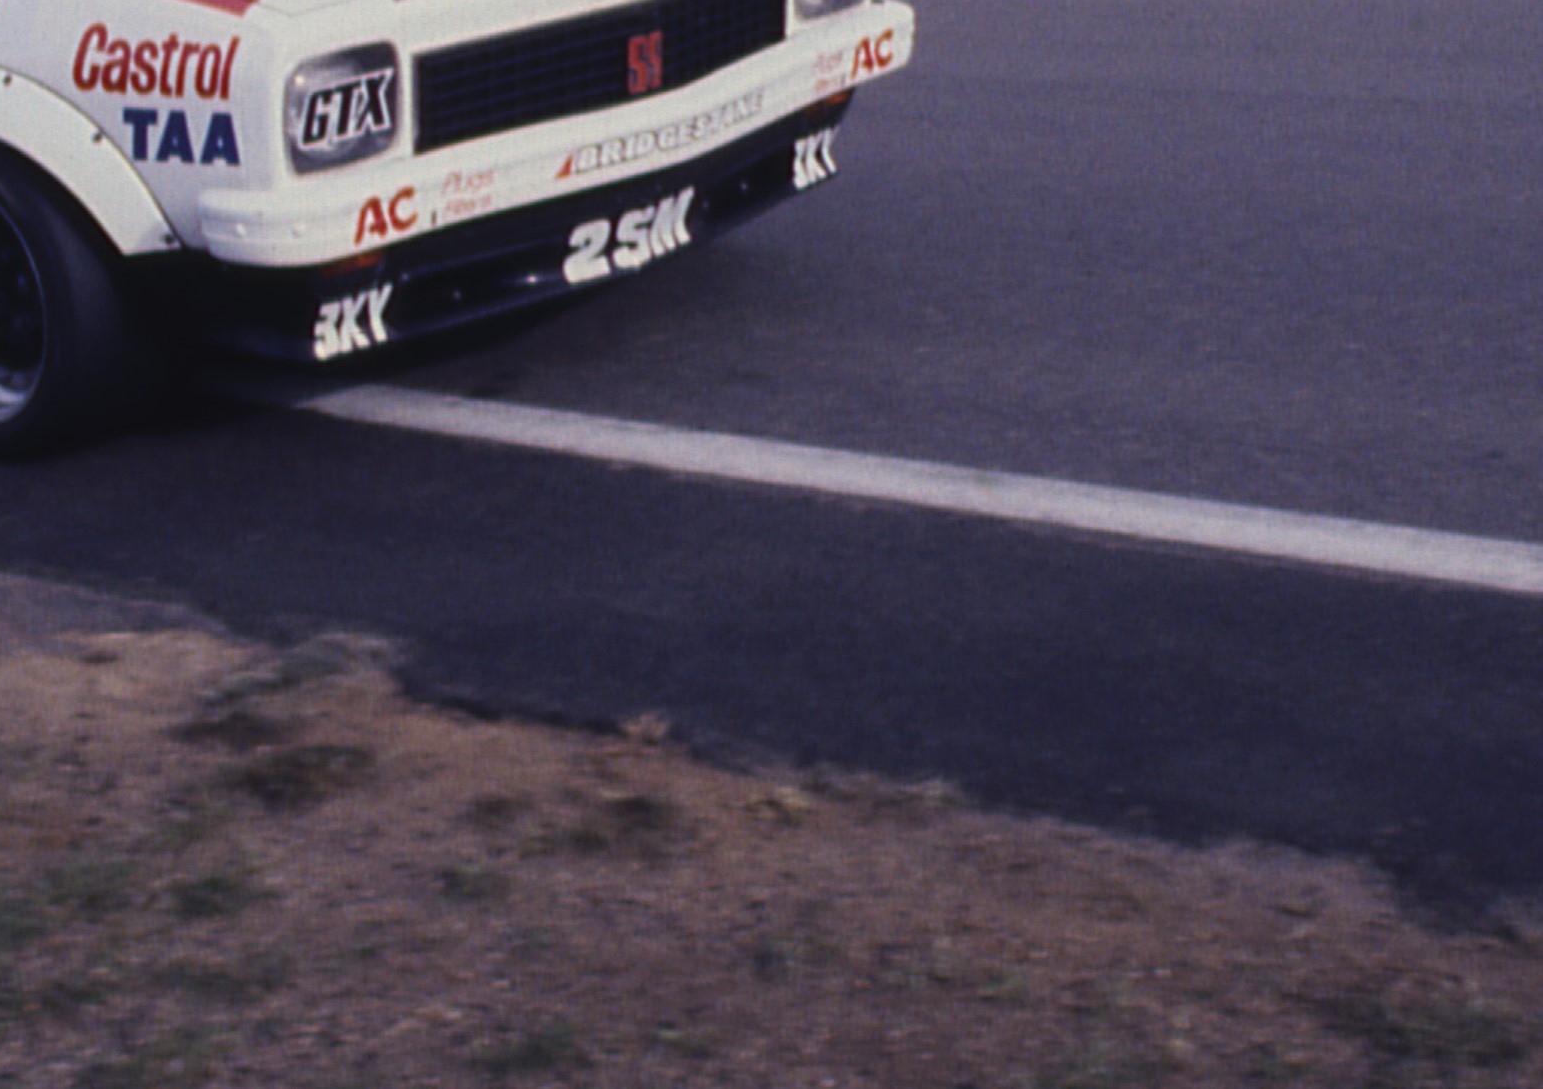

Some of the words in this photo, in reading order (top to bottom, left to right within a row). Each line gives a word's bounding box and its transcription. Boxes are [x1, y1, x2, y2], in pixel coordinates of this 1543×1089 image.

[71, 21, 240, 100] Castrol
[851, 29, 894, 79] AC
[122, 107, 241, 166] TAA
[298, 67, 394, 150] GTX
[354, 186, 419, 246] AC
